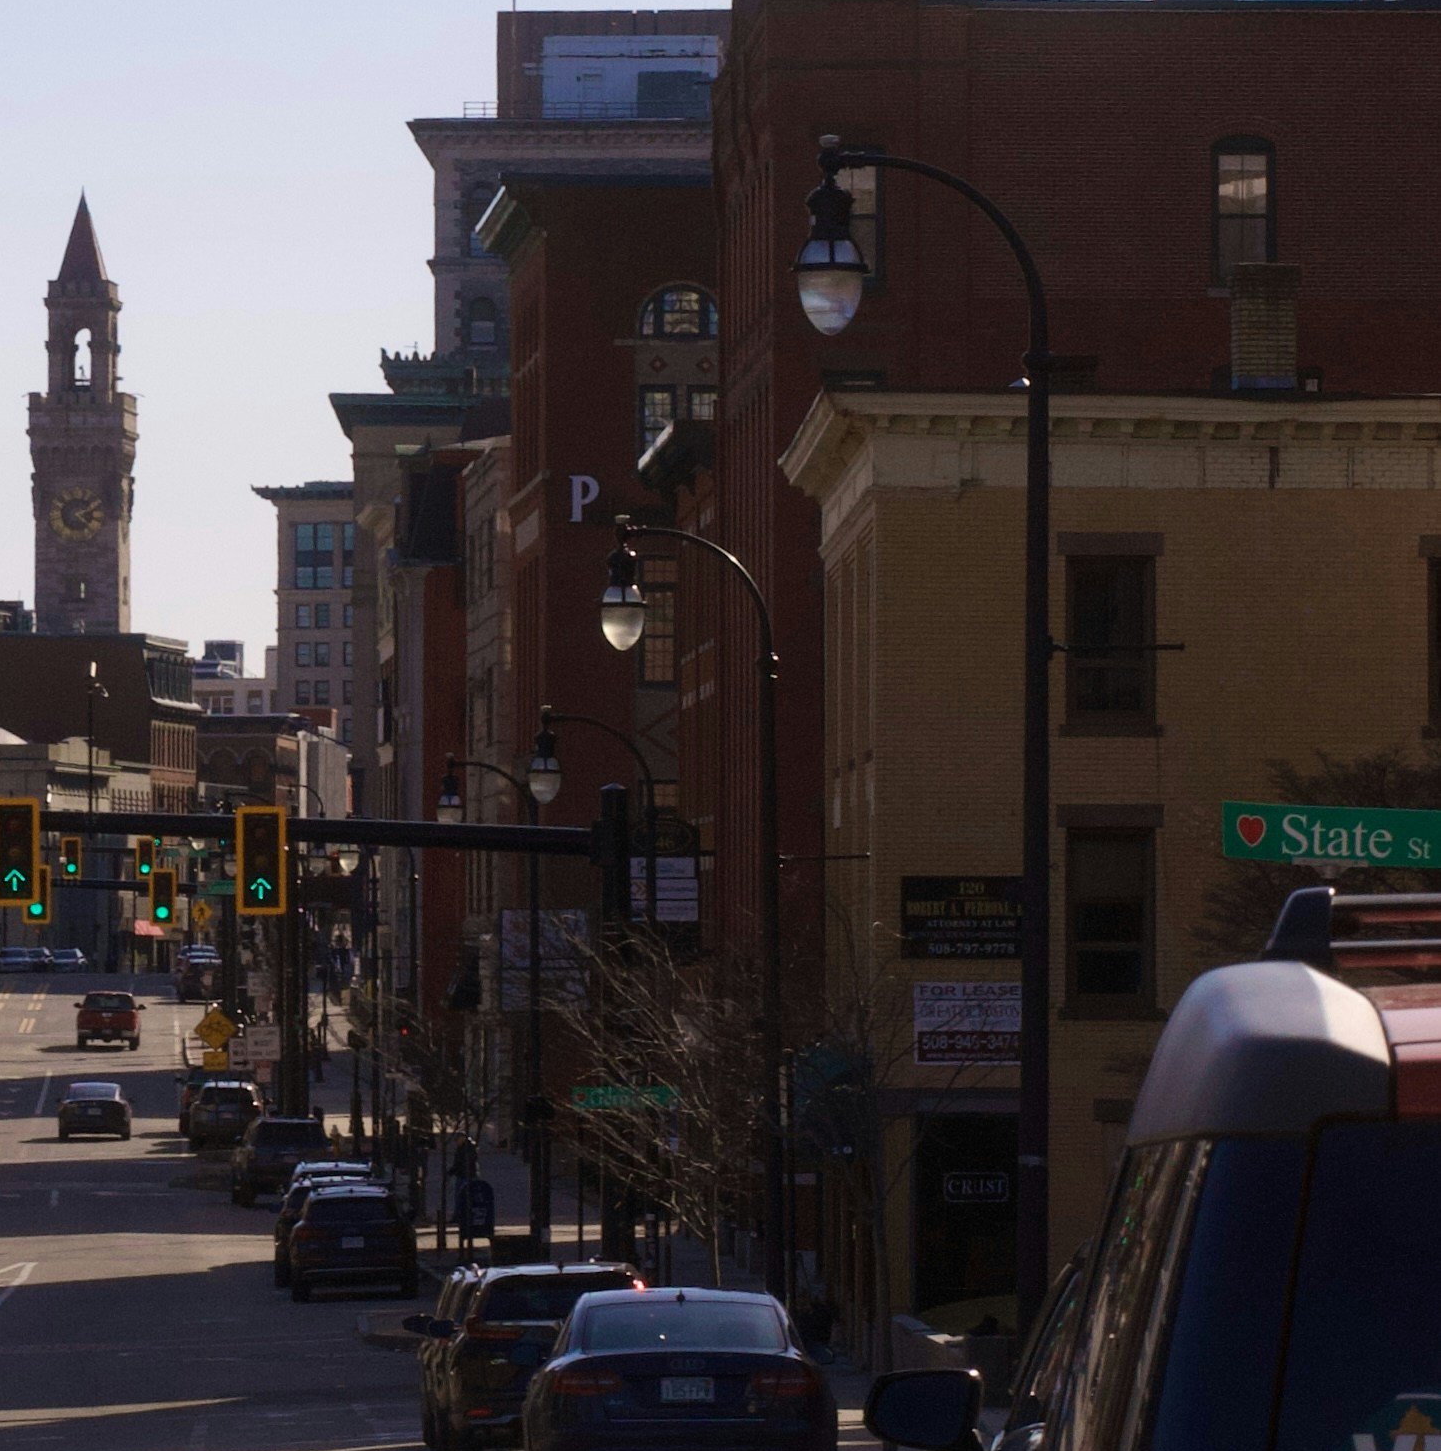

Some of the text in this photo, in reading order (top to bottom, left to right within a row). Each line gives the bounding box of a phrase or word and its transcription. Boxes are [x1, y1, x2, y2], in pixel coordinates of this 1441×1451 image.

[568, 475, 600, 523] P
[1281, 813, 1432, 860] State St
[959, 881, 985, 895] 120
[926, 919, 1017, 928] ATTORNEY AT LAW
[927, 942, 1016, 955] 508-797-9778
[919, 985, 1020, 997] FOR LEASE
[947, 1179, 1004, 1195] CRUST
